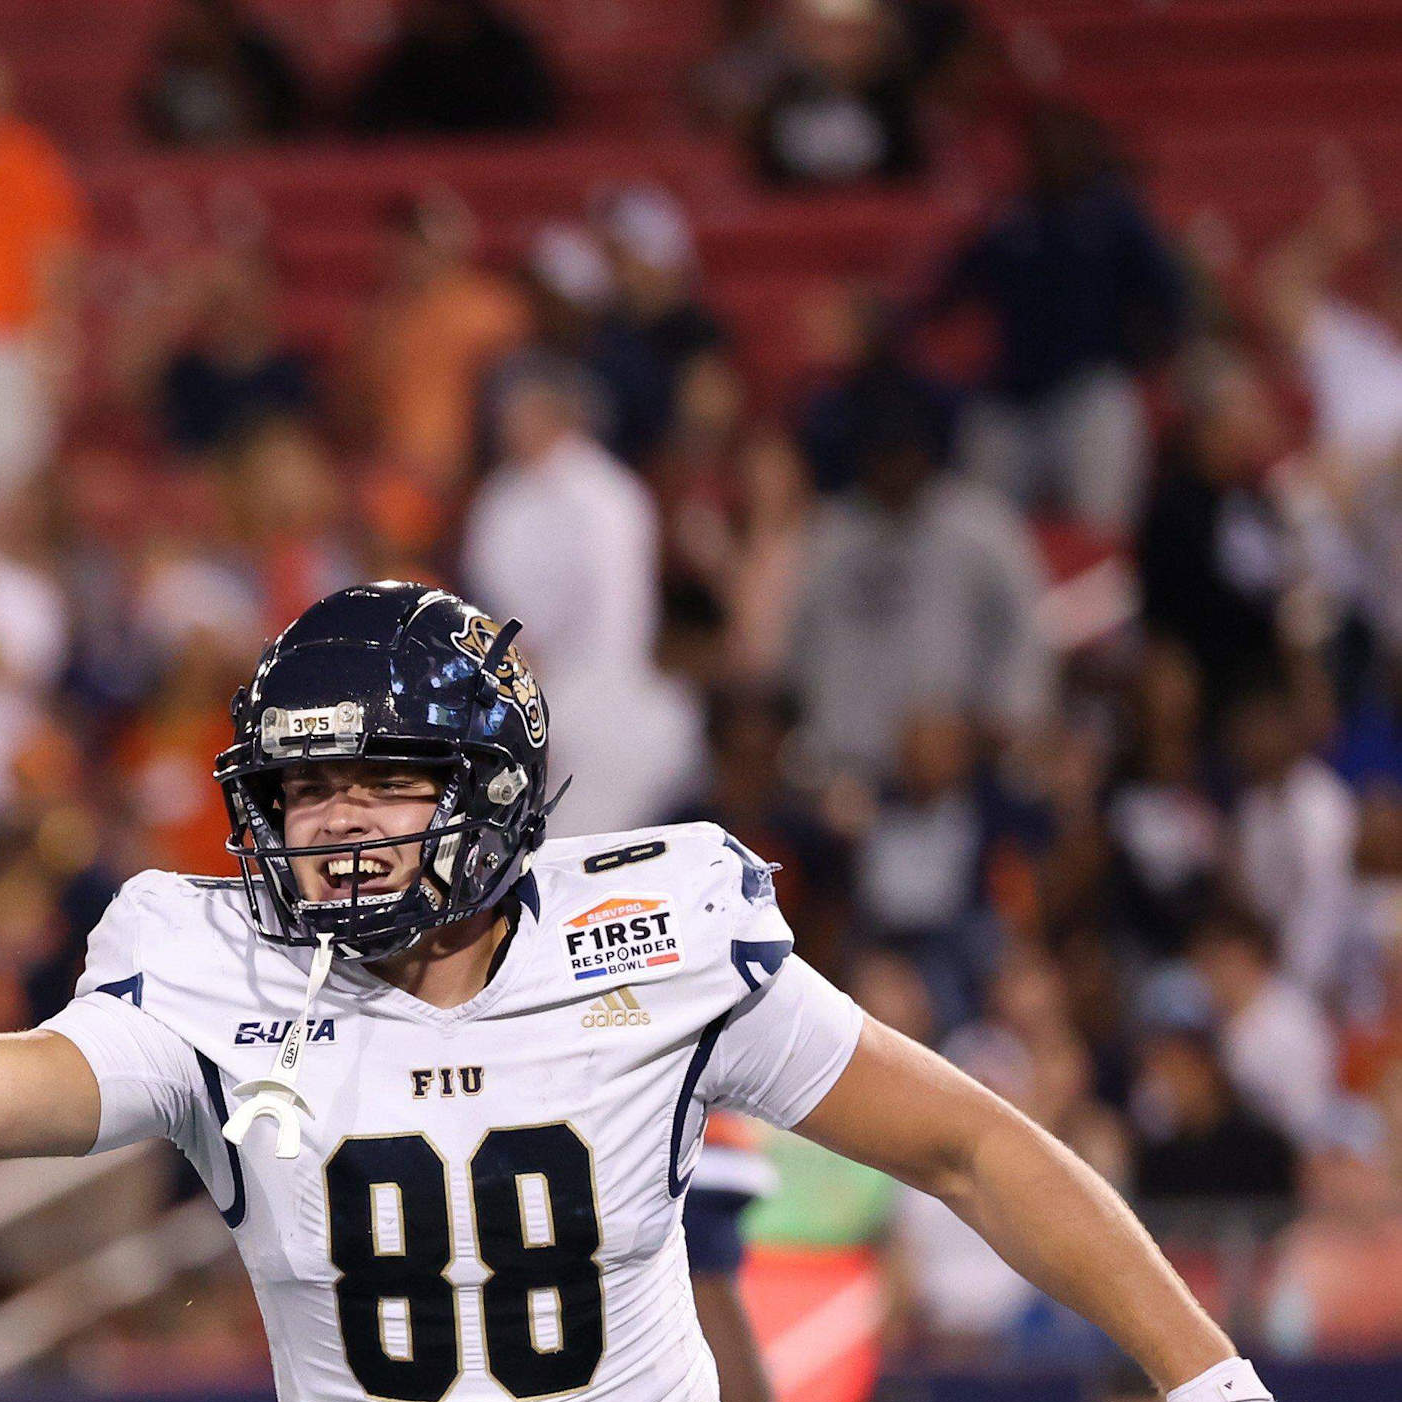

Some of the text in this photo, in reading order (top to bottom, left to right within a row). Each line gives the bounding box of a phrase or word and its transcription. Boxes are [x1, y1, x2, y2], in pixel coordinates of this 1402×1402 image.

[571, 938, 678, 969] RESPONDER
[608, 960, 645, 975] BOWL
[580, 1009, 651, 1029] adidas
[410, 1065, 485, 1100] FIU
